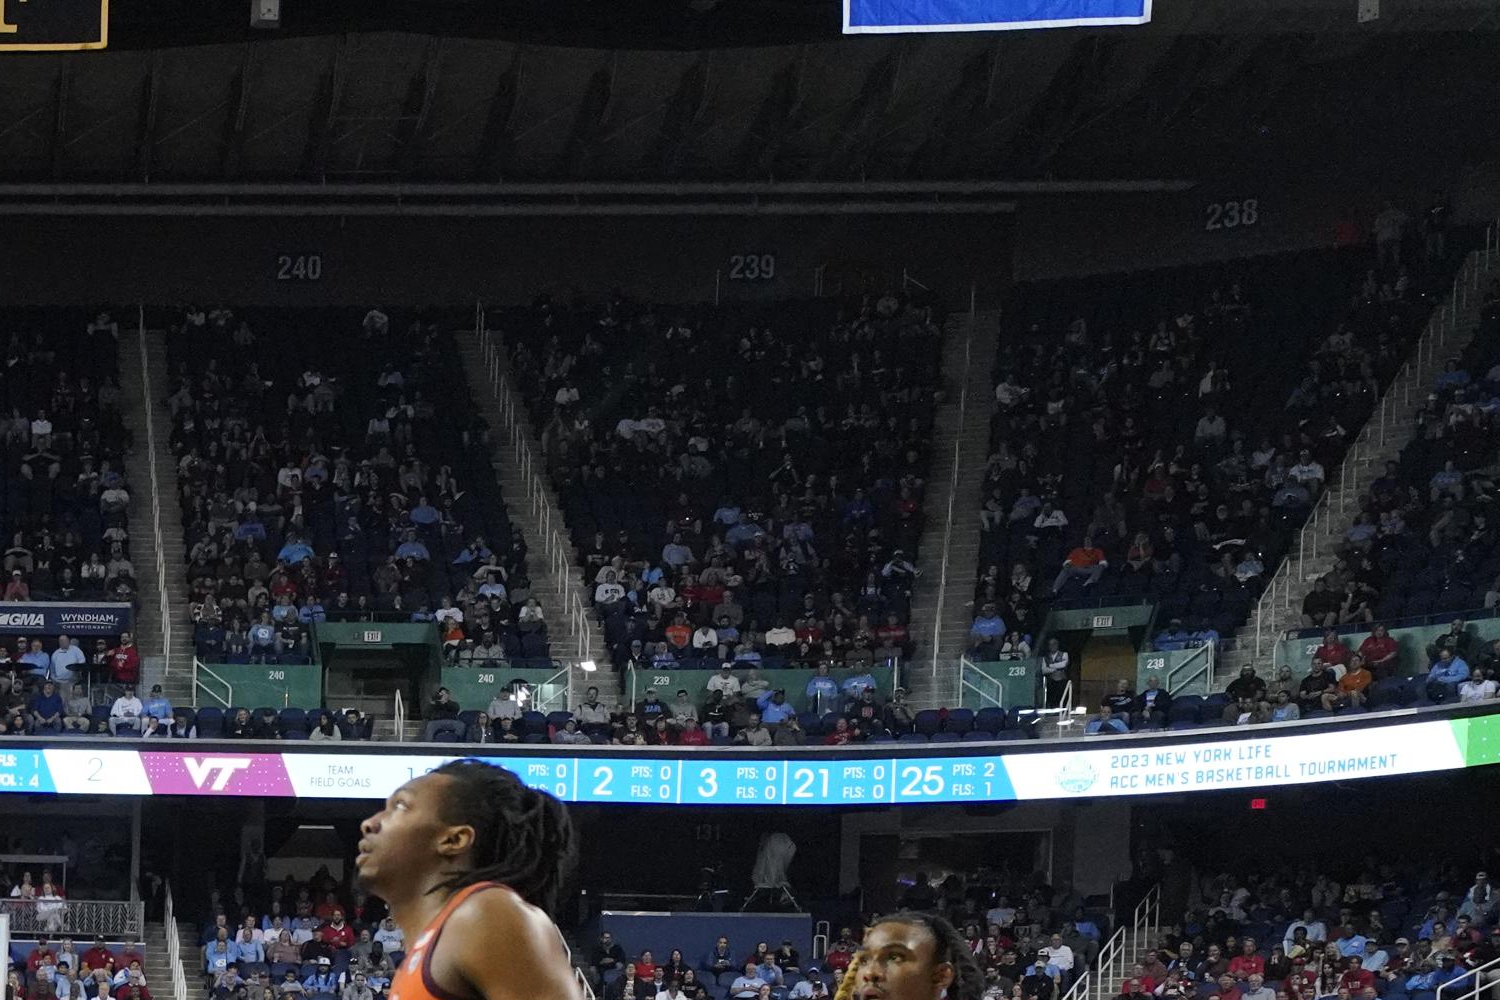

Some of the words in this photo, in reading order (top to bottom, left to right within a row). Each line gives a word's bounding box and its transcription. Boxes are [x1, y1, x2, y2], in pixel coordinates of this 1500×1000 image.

[1206, 202, 1258, 231] 238
[278, 256, 322, 280] 240
[730, 256, 775, 280] 239
[5, 612, 45, 626] GMA
[61, 613, 114, 623] WYNDHAM
[1146, 658, 1165, 670] 238
[268, 670, 285, 681] 240
[478, 674, 494, 684] 240
[1008, 667, 1026, 677] 238
[653, 676, 670, 686] 239
[1111, 753, 1150, 768] 2023
[1156, 751, 1186, 766] NEW
[1194, 747, 1232, 762] YORK
[1238, 744, 1272, 760] LIFE
[87, 757, 103, 782] 2
[183, 757, 253, 790] VT
[328, 765, 354, 776] TEAM
[556, 765, 566, 778] 0
[631, 766, 653, 778] PTS:
[660, 766, 671, 780] 0
[737, 767, 758, 779] PTS:
[765, 767, 776, 781] 0
[844, 767, 865, 779] PTS:
[873, 765, 884, 780] 0
[953, 764, 975, 776] PTS:
[984, 762, 995, 777] 2
[1110, 773, 1138, 788] ACC
[1145, 770, 1189, 787] MEN'S
[1195, 764, 1291, 784] BASKETBALL
[1299, 754, 1398, 777] TOURNAMENT
[29, 775, 39, 788] 4
[310, 777, 335, 788] FIELD
[337, 777, 371, 788] GOALS
[592, 766, 613, 795] 2
[698, 767, 718, 797] 3
[793, 768, 828, 798] 21
[900, 766, 944, 796] 25
[555, 784, 566, 797] 0
[631, 785, 652, 797] FLS:
[659, 785, 670, 799] 0
[736, 786, 757, 798] FLS:
[764, 786, 776, 800] 0
[843, 786, 864, 798] FLS:
[872, 785, 884, 799] 0
[952, 784, 975, 796] FLS:
[985, 782, 992, 796] 1
